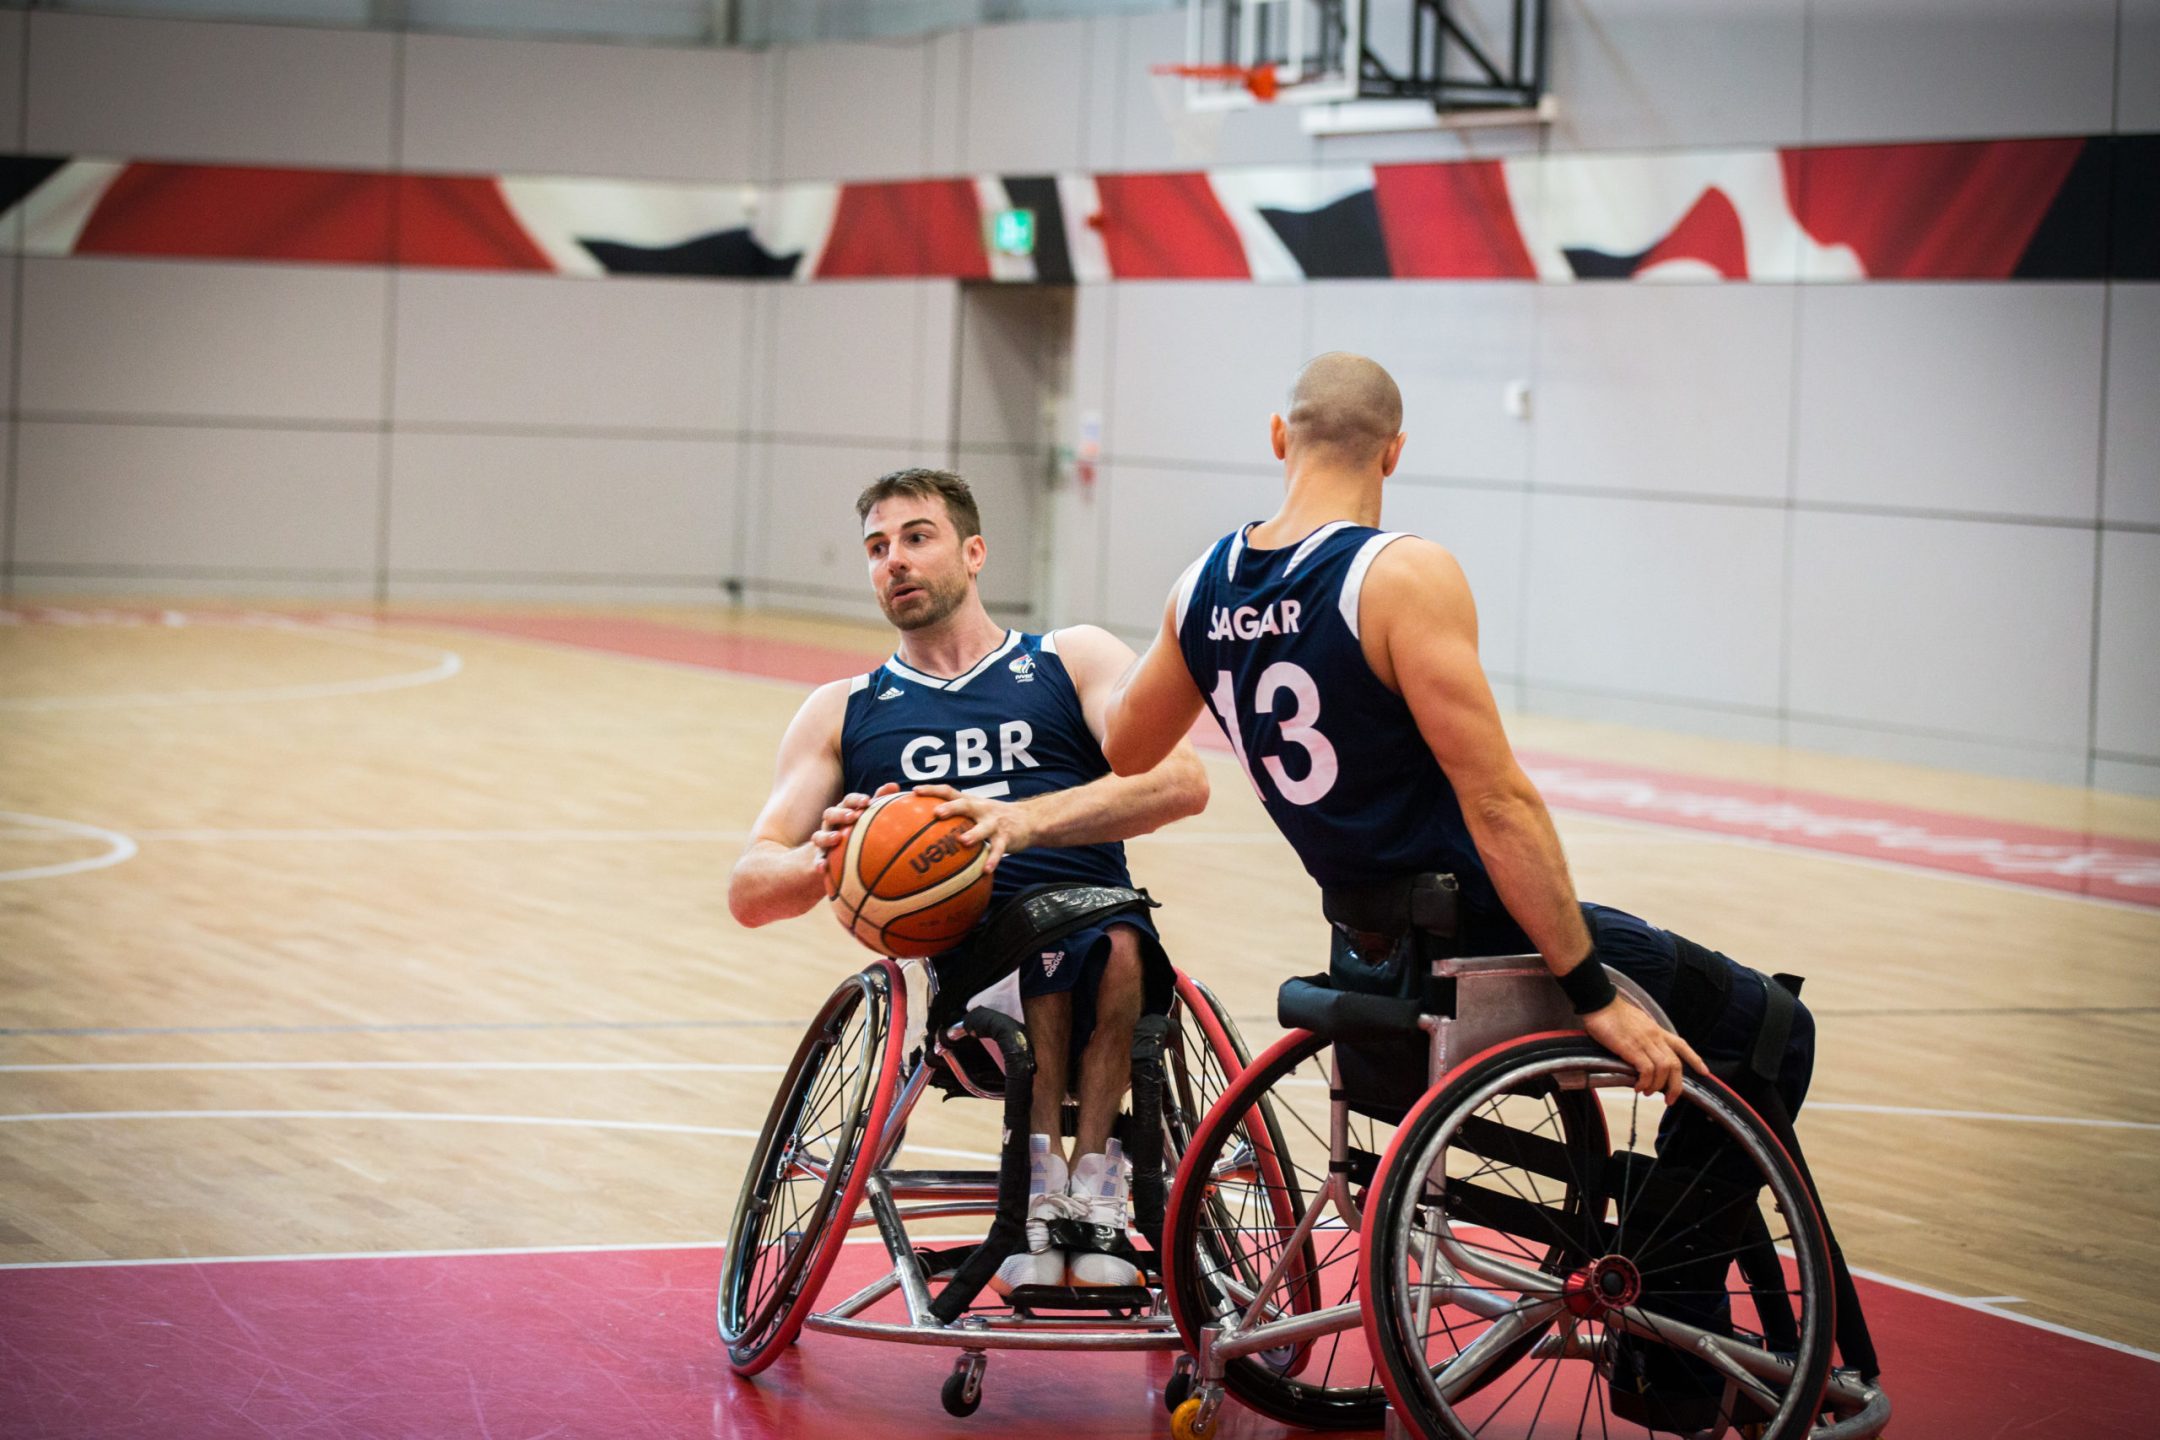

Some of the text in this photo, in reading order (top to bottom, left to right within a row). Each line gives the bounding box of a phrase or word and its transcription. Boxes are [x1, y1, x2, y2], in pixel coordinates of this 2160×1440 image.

[1207, 600, 1301, 641] SAGAR
[901, 720, 1040, 781] GBR
[1210, 661, 1339, 806] 13
